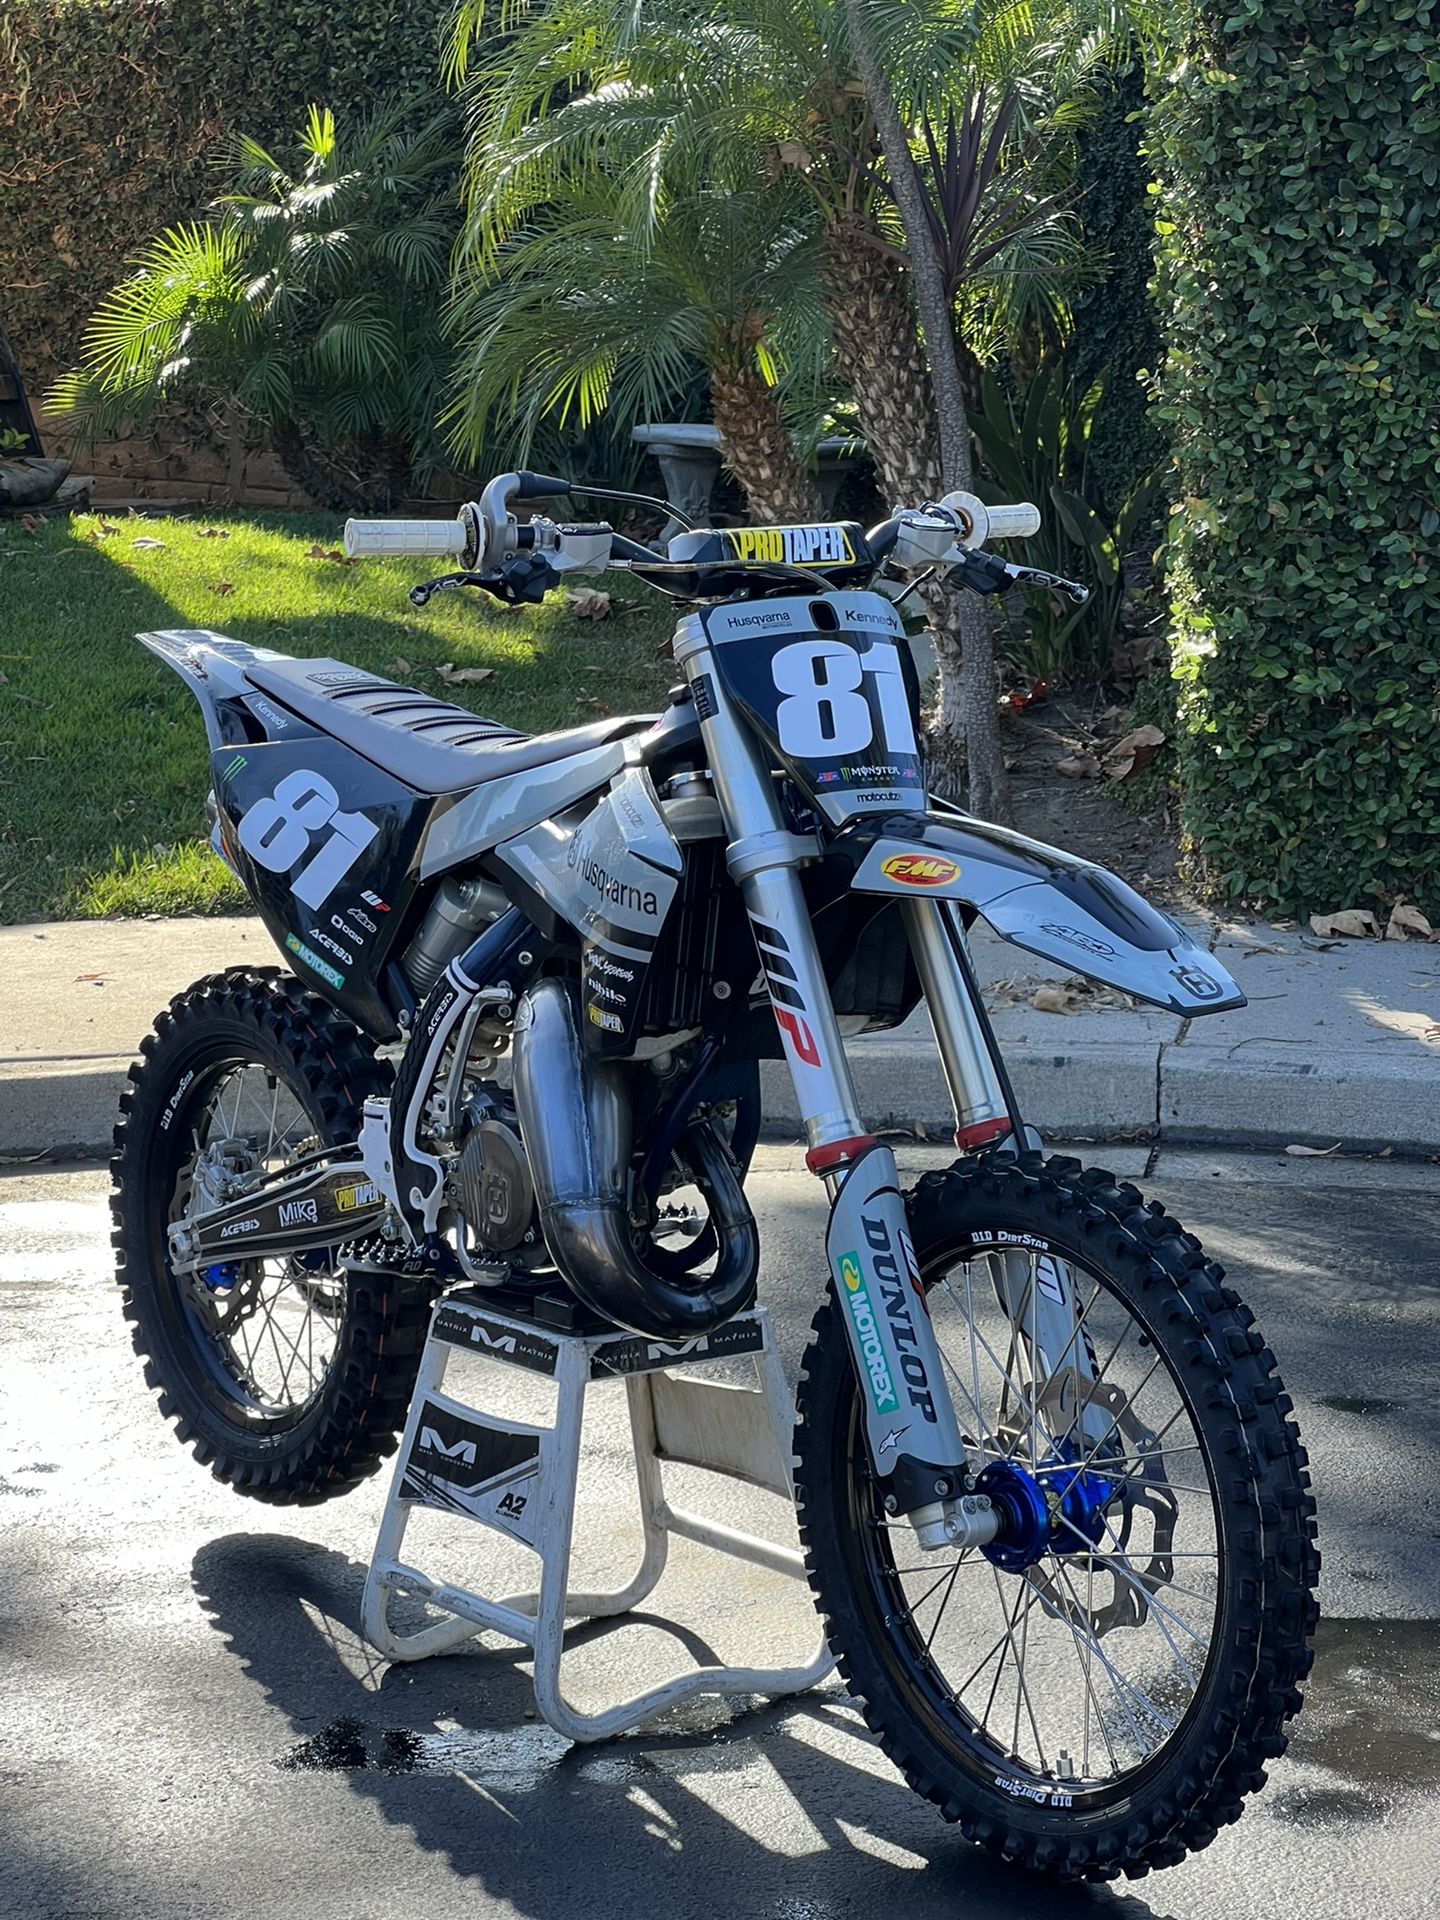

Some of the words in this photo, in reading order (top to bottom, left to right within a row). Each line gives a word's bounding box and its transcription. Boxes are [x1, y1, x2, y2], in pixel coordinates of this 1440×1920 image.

[740, 526, 846, 563] PROTAPER
[727, 611, 791, 629] Husqvarna
[845, 609, 898, 630] Kennedy
[255, 700, 288, 730] Kennedy
[771, 640, 917, 757] 81
[851, 764, 900, 777] MONSTER
[237, 769, 380, 912] 81
[577, 845, 658, 916] Husqvarna
[884, 859, 957, 878] FMF
[360, 890, 391, 912] WP
[309, 928, 353, 965] ACERBIS
[298, 943, 342, 988] MOTOREX
[427, 992, 453, 1036] ACERBIS
[220, 1219, 261, 1238] ACERBIS
[278, 1198, 317, 1228] Mika
[860, 1214, 938, 1424] DUNLOP
[435, 1318, 468, 1334] MATRIX
[518, 1344, 554, 1363] MATRIX
[713, 1331, 759, 1345] MATRIX
[850, 1291, 896, 1408] MOTOREX
[497, 1492, 528, 1515] A2
